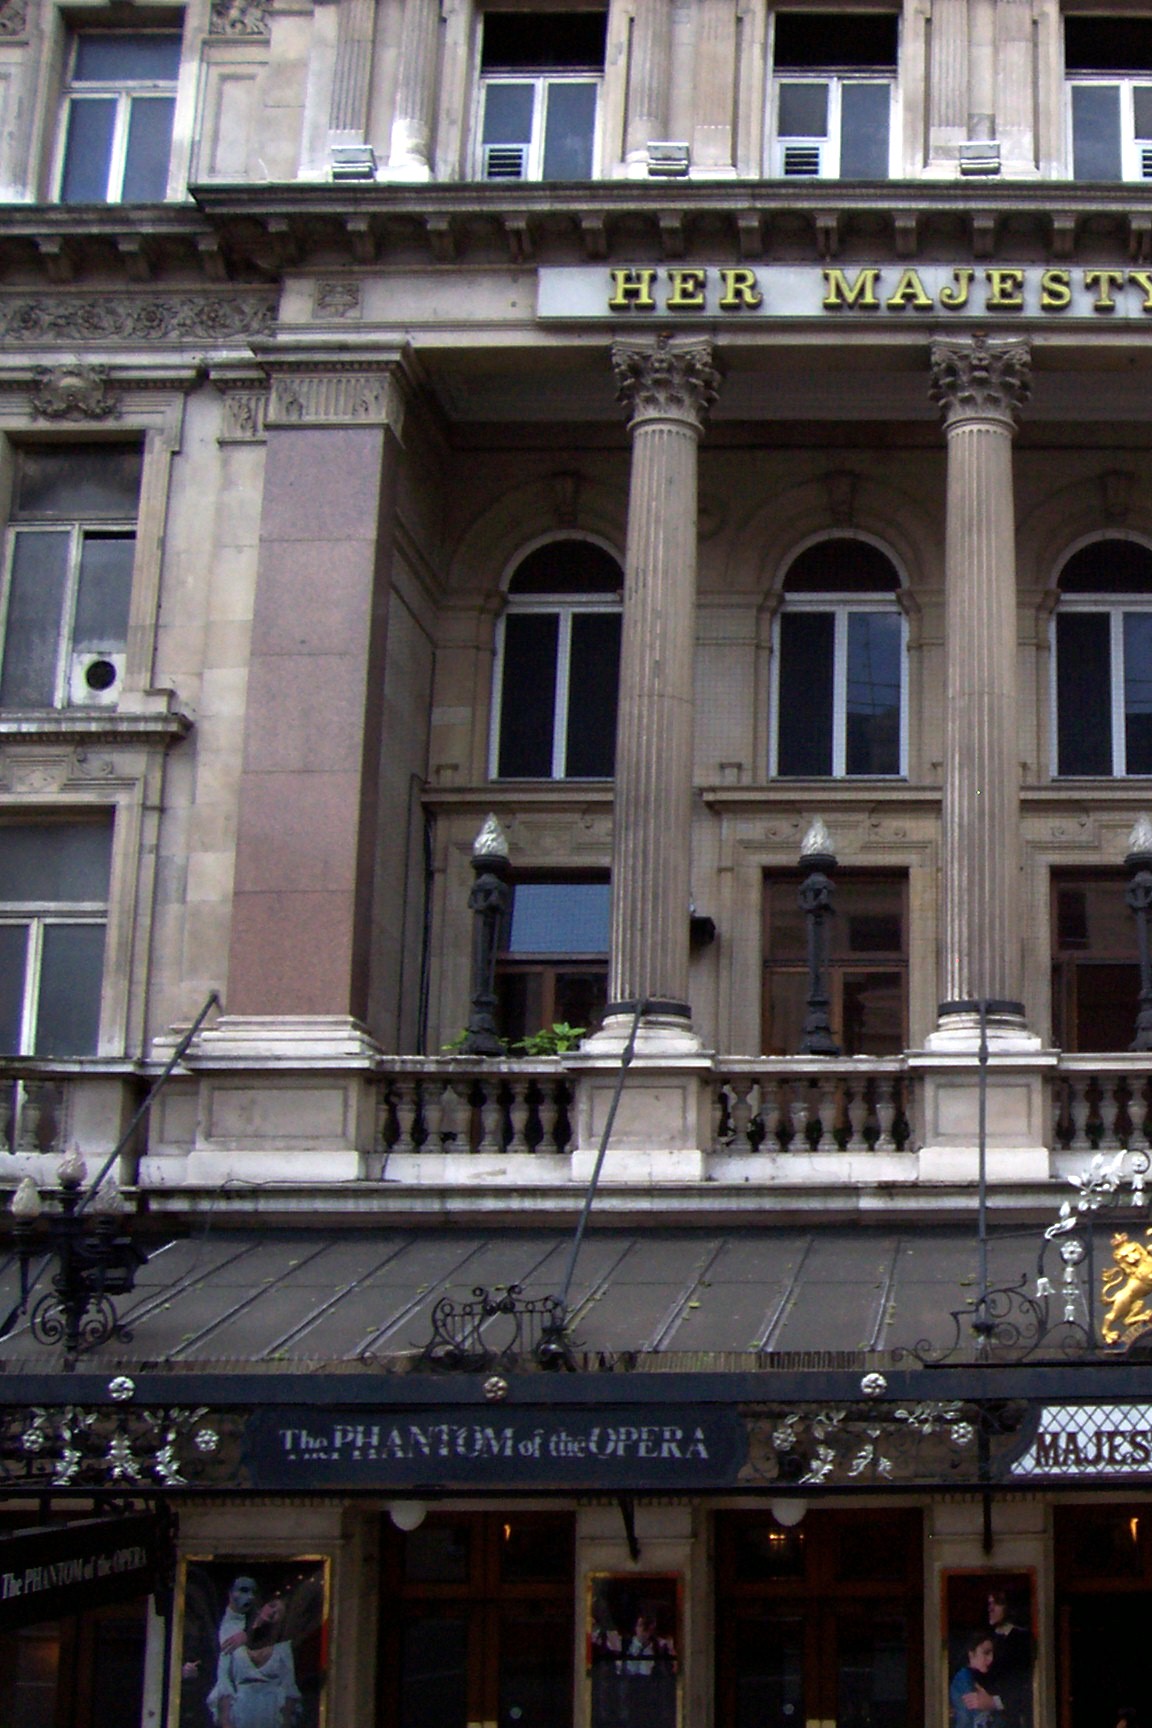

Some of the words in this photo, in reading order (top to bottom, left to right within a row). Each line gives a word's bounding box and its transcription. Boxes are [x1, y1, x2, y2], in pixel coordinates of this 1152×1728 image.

[608, 267, 763, 311] HER
[278, 1428, 330, 1460] The
[333, 1423, 514, 1460] PHANTOM
[518, 1428, 545, 1458] of
[549, 1428, 587, 1458] the
[588, 1426, 710, 1459] OPERA
[23, 1557, 84, 1594] PHANTOM
